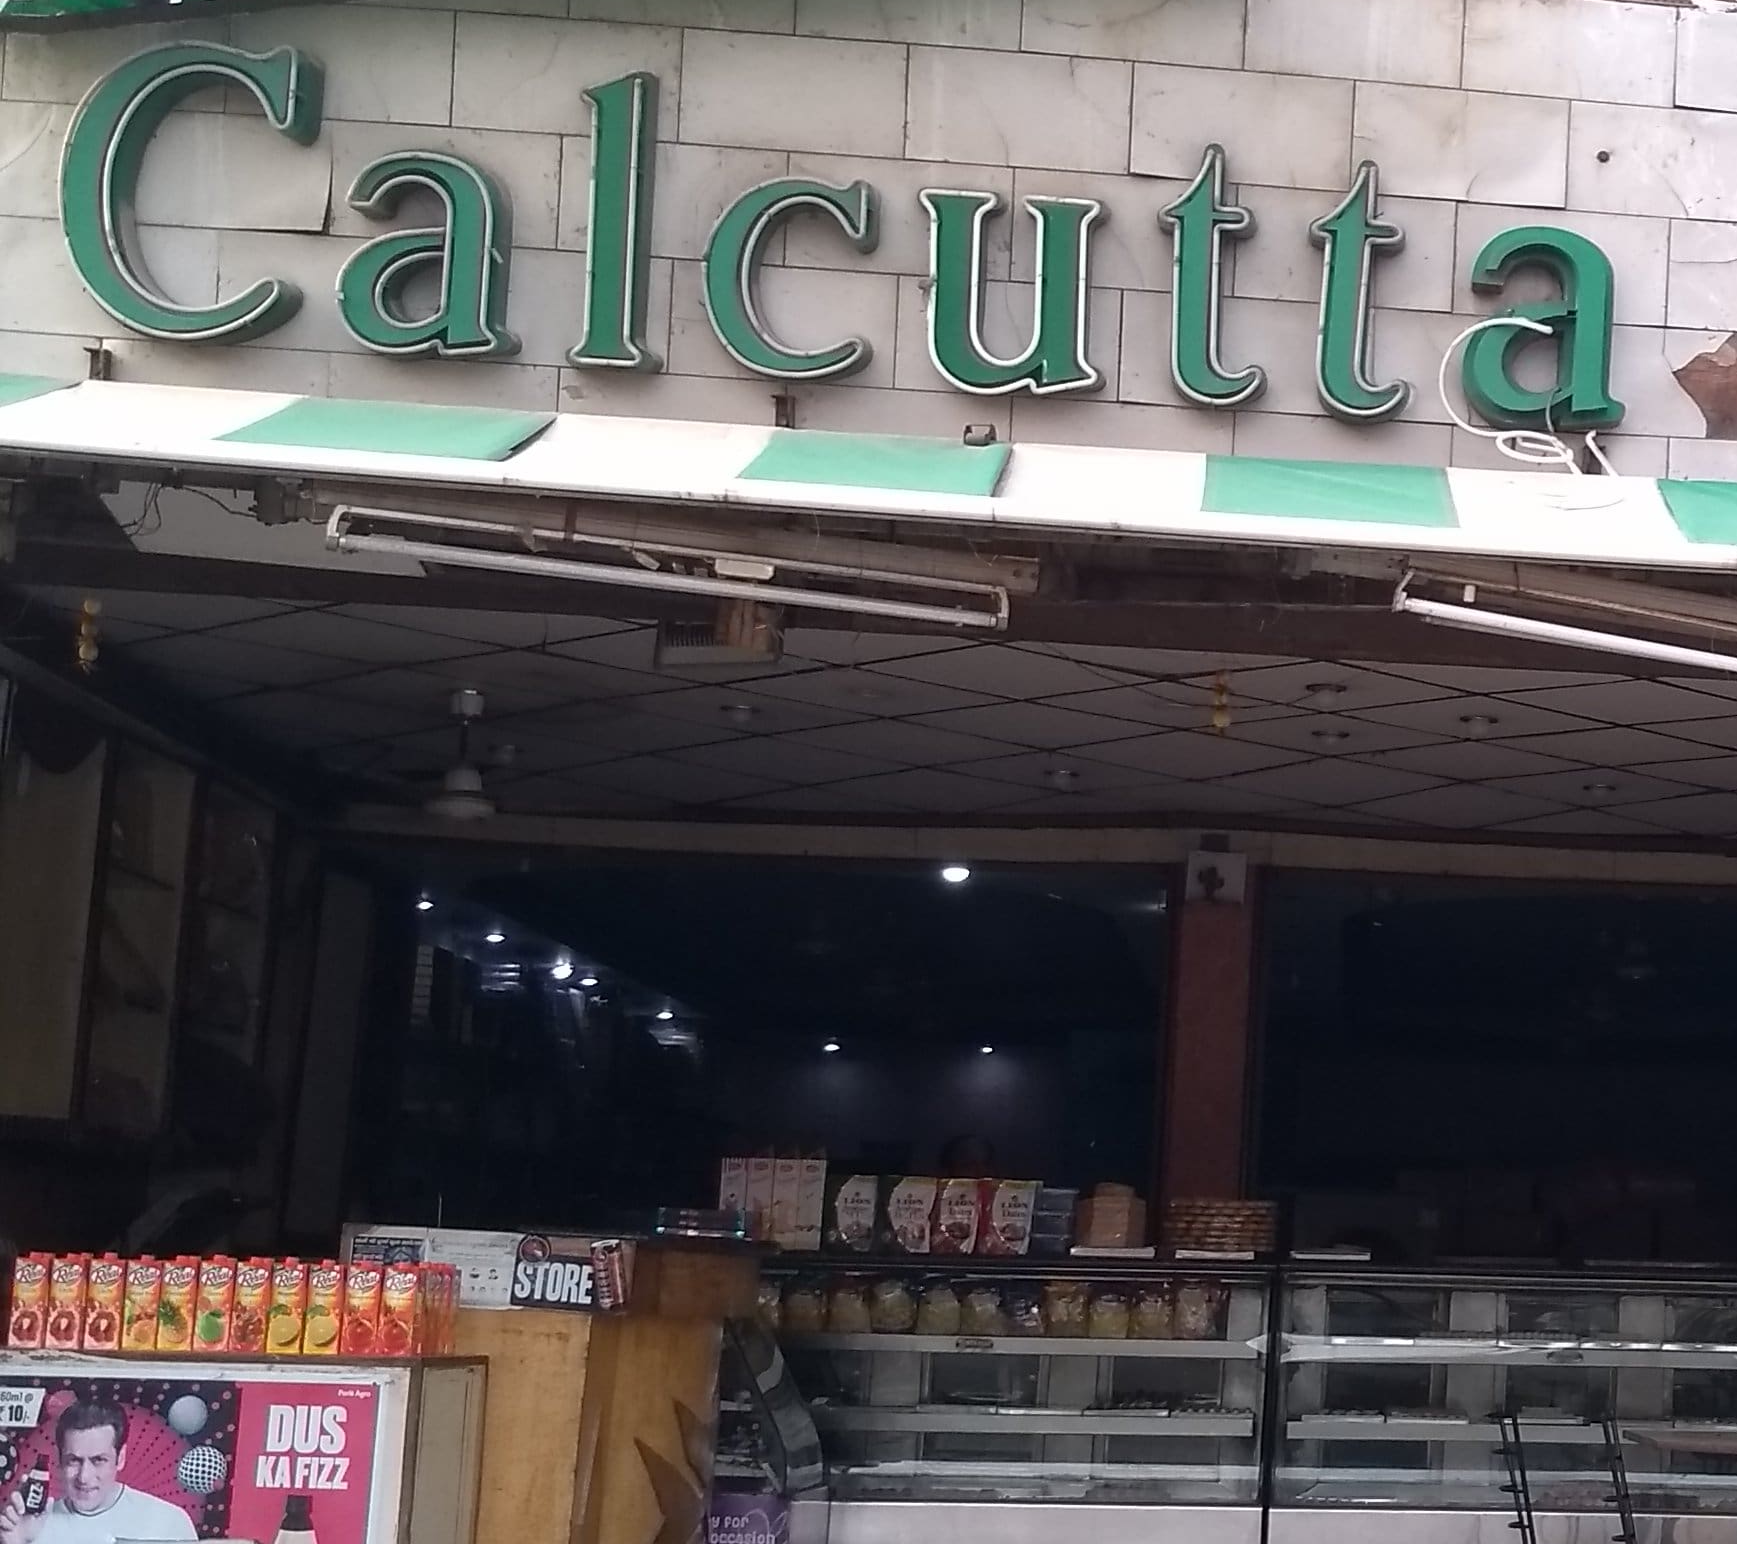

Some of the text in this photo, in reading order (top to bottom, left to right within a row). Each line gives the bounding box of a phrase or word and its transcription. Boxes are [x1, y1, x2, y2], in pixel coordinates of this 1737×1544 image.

[57, 40, 1627, 433] Calcutta
[514, 1262, 596, 1305] STORE
[266, 1404, 348, 1454] DUS
[255, 1455, 350, 1490] KA FIZZ
